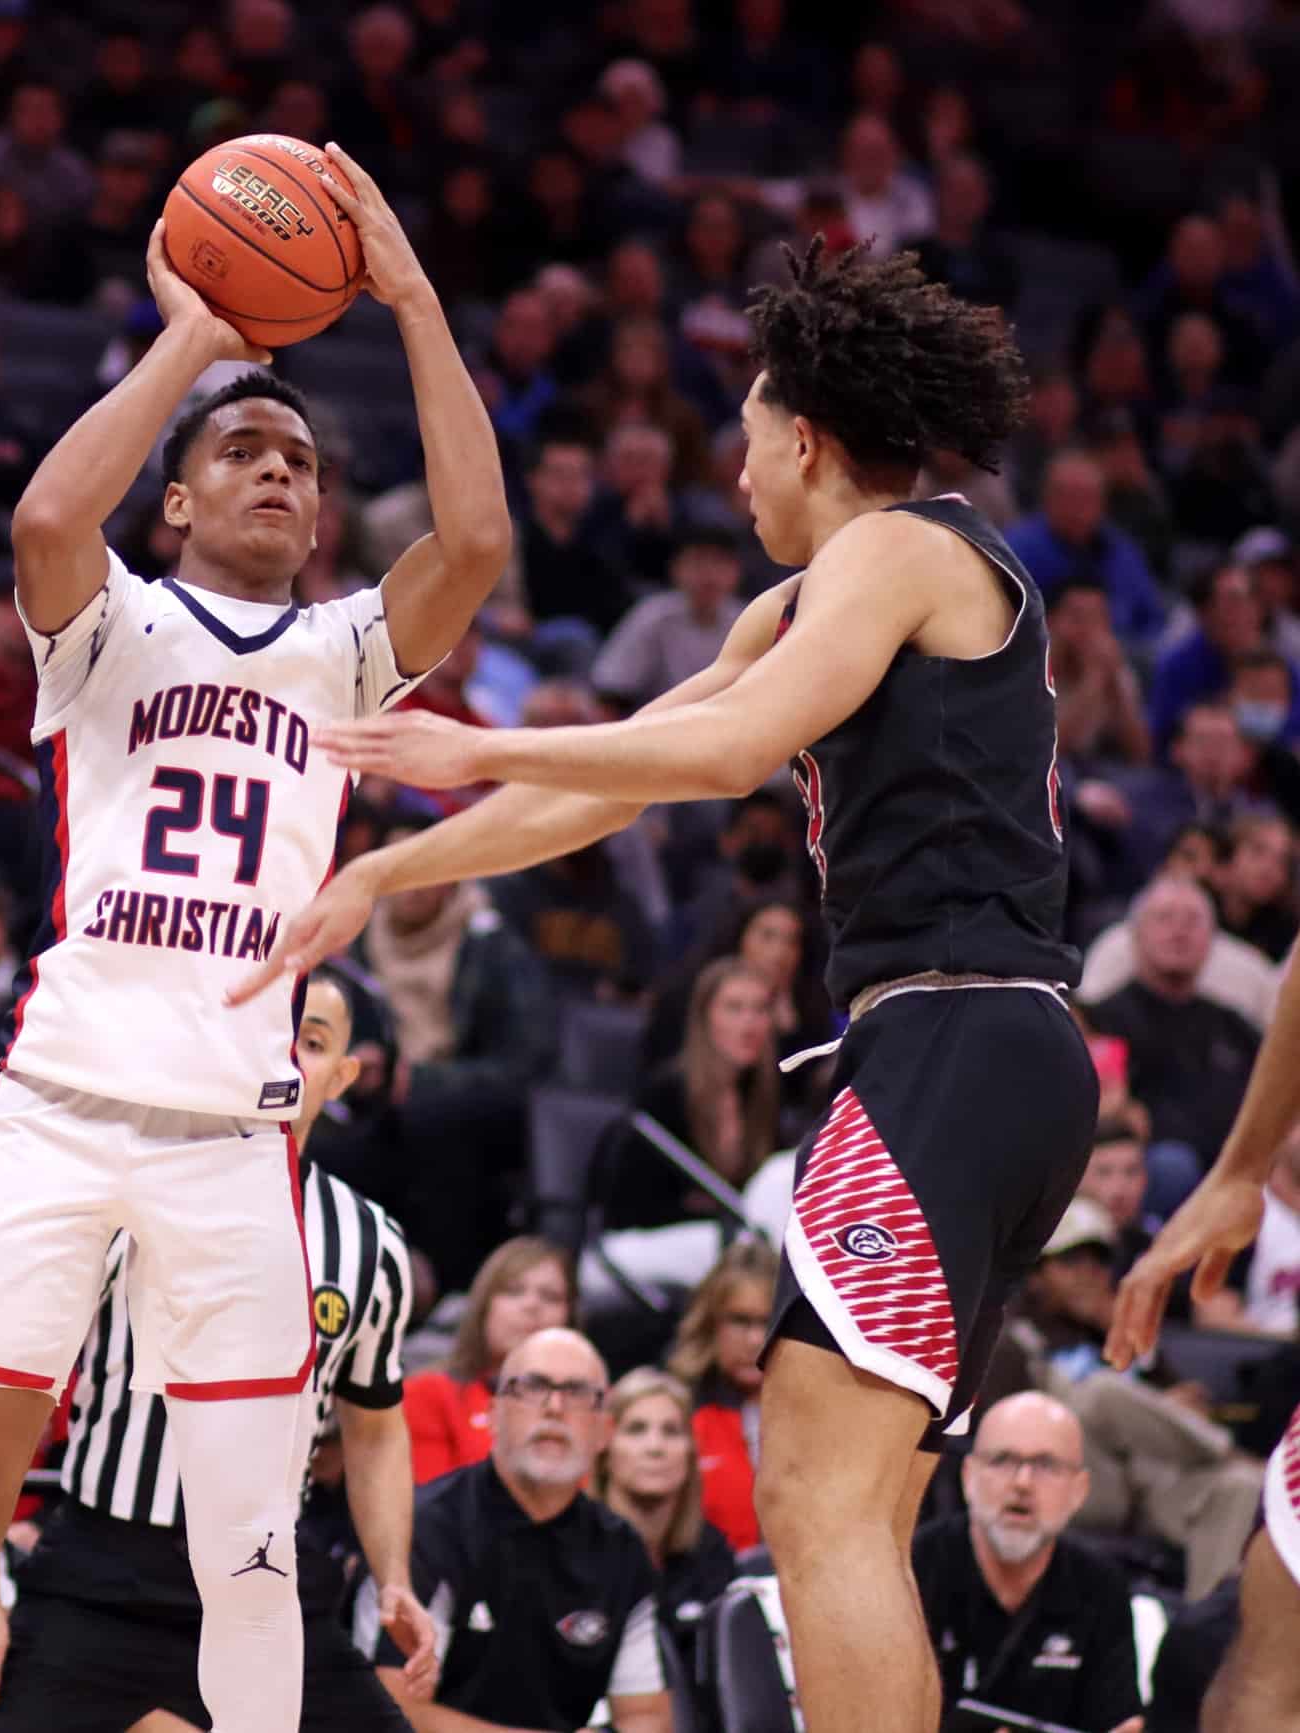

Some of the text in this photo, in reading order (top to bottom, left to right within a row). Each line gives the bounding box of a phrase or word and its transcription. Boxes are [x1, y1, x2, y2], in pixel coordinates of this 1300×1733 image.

[214, 158, 314, 238] LEGACY
[230, 188, 292, 241] 1000
[126, 683, 310, 776] MODESTO
[140, 765, 271, 887] 24
[83, 888, 281, 962] CHRISTIAN
[314, 1291, 346, 1334] CIF
